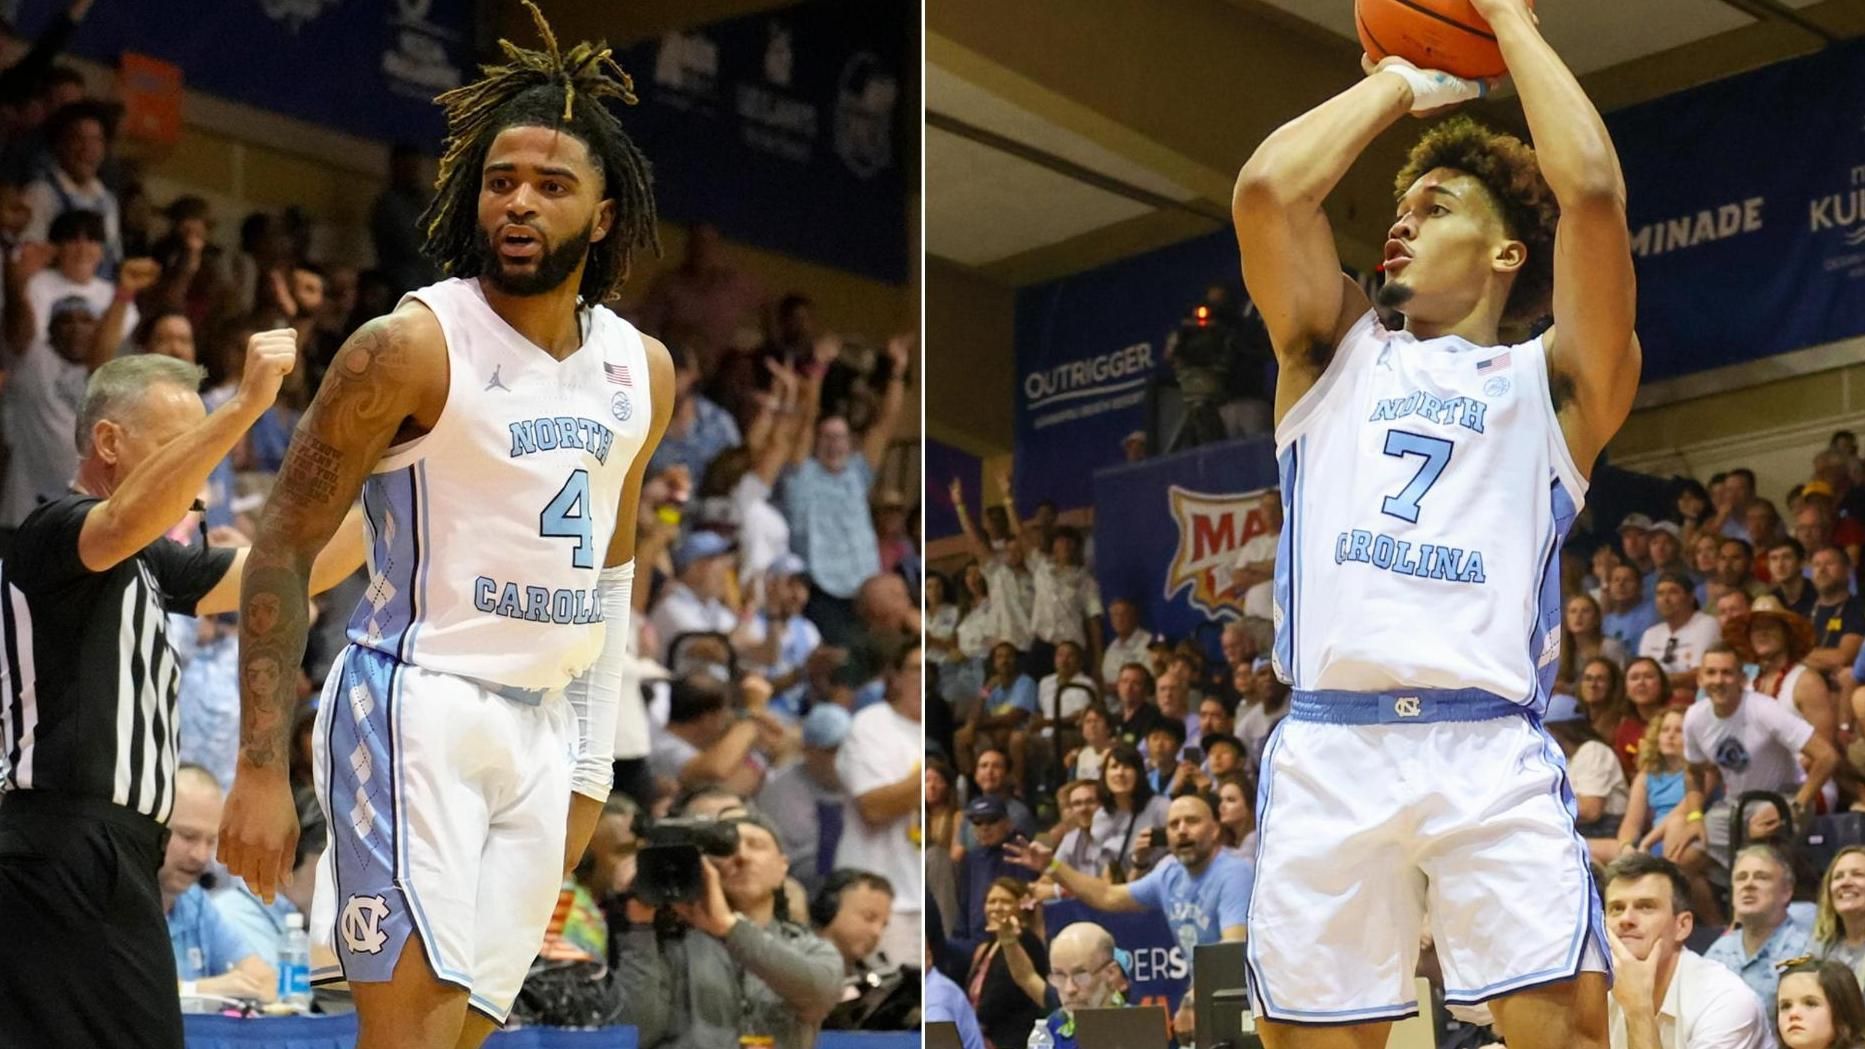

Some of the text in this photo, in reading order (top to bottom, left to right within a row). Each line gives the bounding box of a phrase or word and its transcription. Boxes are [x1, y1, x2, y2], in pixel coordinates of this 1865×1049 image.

[1627, 196, 1765, 257] MINADE
[1024, 342, 1156, 400] OUTRIGGER
[1369, 390, 1488, 434] NORTH
[510, 416, 615, 466] NORTH
[1381, 428, 1454, 524] 7
[540, 468, 594, 569] 4
[1191, 508, 1268, 562] MA
[1335, 529, 1487, 584] CROLINA
[474, 575, 606, 624] CAROLI
